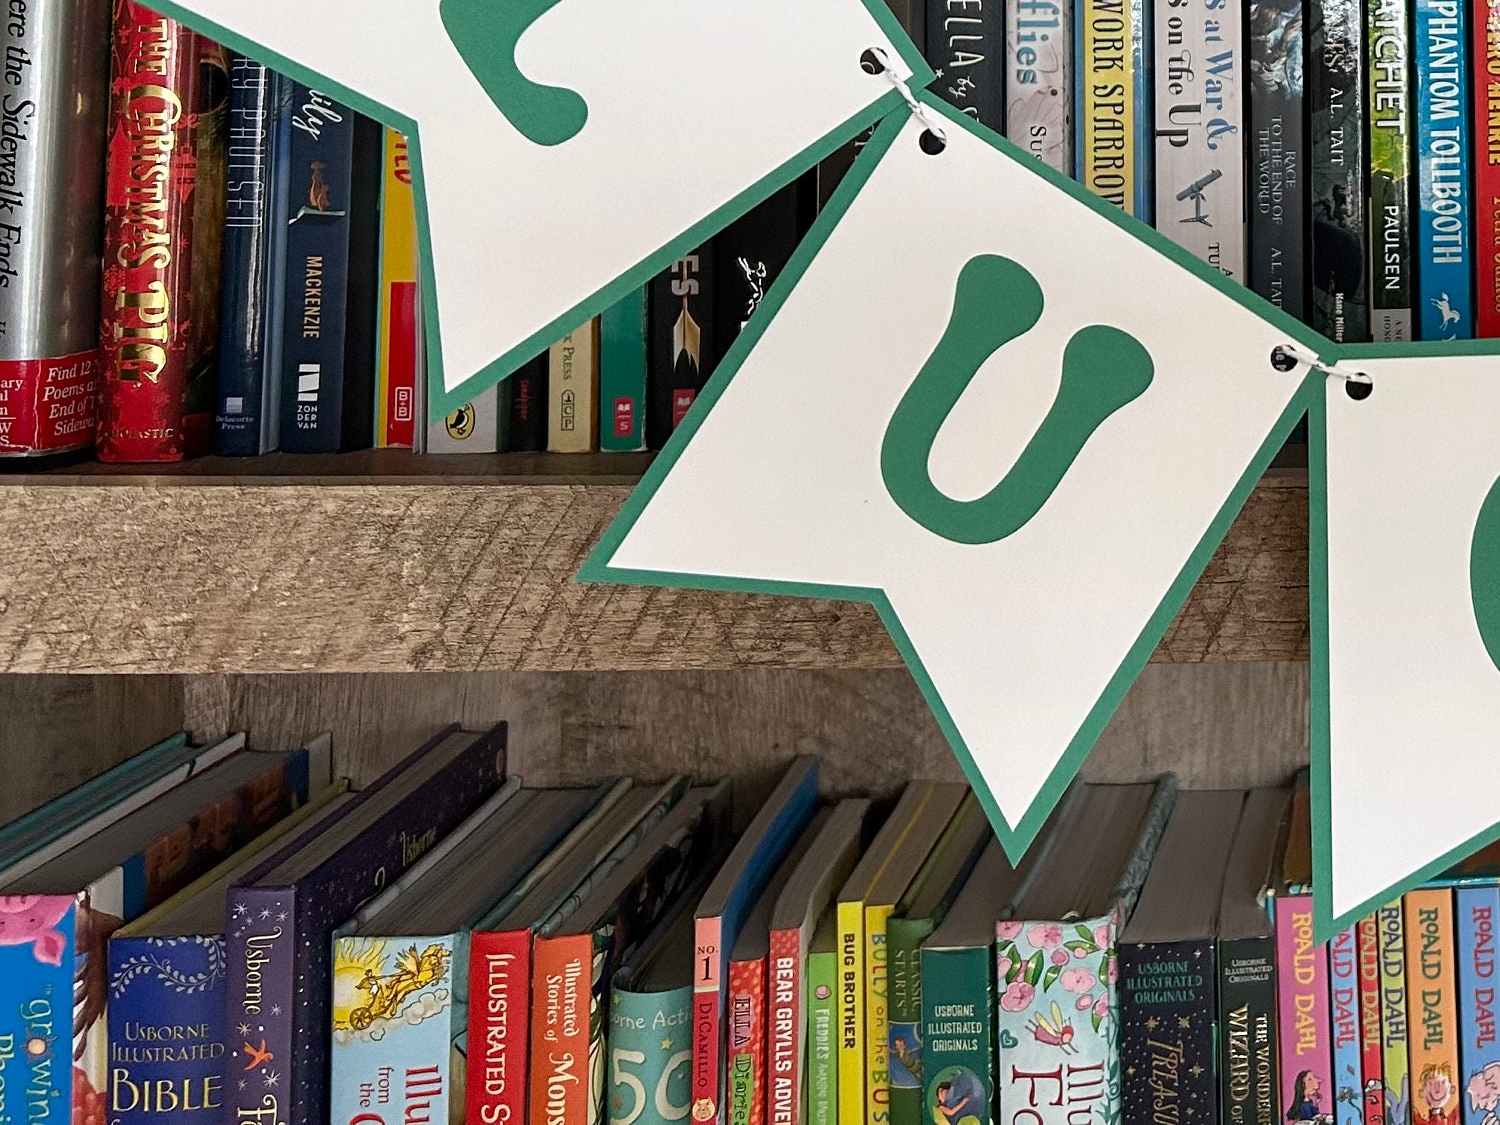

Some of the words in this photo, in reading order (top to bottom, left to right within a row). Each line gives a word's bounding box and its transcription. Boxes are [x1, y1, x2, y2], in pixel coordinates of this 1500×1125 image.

[134, 18, 168, 75] THE
[1168, 17, 1183, 45] on
[1205, 19, 1222, 43] at
[6, 46, 32, 86] the
[1168, 49, 1194, 95] the
[1205, 49, 1233, 111] War
[1428, 0, 1460, 120] PHANTOM
[949, 76, 976, 99] by
[1330, 87, 1344, 119] A.L.
[1156, 104, 1202, 148] Up
[1206, 117, 1239, 150] &
[1259, 128, 1270, 158] THE
[1271, 115, 1282, 136] TO
[0, 93, 36, 215] Sidewalk
[1271, 139, 1282, 168] THE
[1330, 126, 1344, 166] TAIT
[118, 84, 182, 269] CHRISTMAS
[1258, 162, 1270, 214] WORLD
[1271, 171, 1282, 203] END
[1285, 150, 1296, 188] RACE
[1271, 205, 1282, 225] OF
[1430, 126, 1462, 264] TOLLBOOTH
[0, 225, 22, 288] Ends
[1384, 205, 1400, 290] PAULSEN
[303, 256, 323, 338] MACKENZIE
[1335, 292, 1344, 318] Kane
[114, 280, 170, 384] PIG
[1335, 319, 1343, 343] Miller
[881, 254, 1154, 544] U
[298, 421, 317, 429] VAN
[697, 945, 719, 954] NO.
[843, 933, 855, 966] BUG
[1292, 911, 1316, 985] ROALD
[1381, 906, 1404, 978] ROALD
[1419, 907, 1442, 980] ROALD
[1472, 906, 1494, 979] ROALD
[243, 926, 282, 1015] Usborne
[702, 956, 713, 981] 1
[776, 957, 793, 1003] BEAR
[1127, 975, 1203, 990] ILLUSTRATED
[1138, 961, 1190, 975] USBORNE
[546, 974, 562, 1028] Stories
[563, 958, 582, 1037] Illustrated
[844, 971, 856, 1049] BROTHER
[935, 1005, 975, 1016] USBORNE
[1134, 989, 1195, 1004] ORIGINALS
[125, 1022, 210, 1041] USBORNE
[485, 953, 515, 1096] ILLUSTRATED
[544, 1031, 558, 1044] of
[734, 997, 751, 1047] ELLA
[876, 1007, 884, 1028] on
[928, 1021, 983, 1035] ILLUSTRATED
[1256, 1013, 1268, 1044] THE
[1294, 993, 1317, 1056] DAHL
[1384, 987, 1405, 1048] DAHL
[1422, 989, 1443, 1051] DAHL
[1475, 987, 1496, 1049] DAHL
[112, 1042, 225, 1063] ILLUSTRATED
[775, 1007, 793, 1072] GRYLLS
[875, 1035, 888, 1064] the
[933, 1039, 978, 1051] ORIGINALS
[1229, 1003, 1250, 1101] WIZARD
[112, 1068, 224, 1113] BIBLE
[359, 1083, 375, 1108] the
[378, 1066, 395, 1104] from
